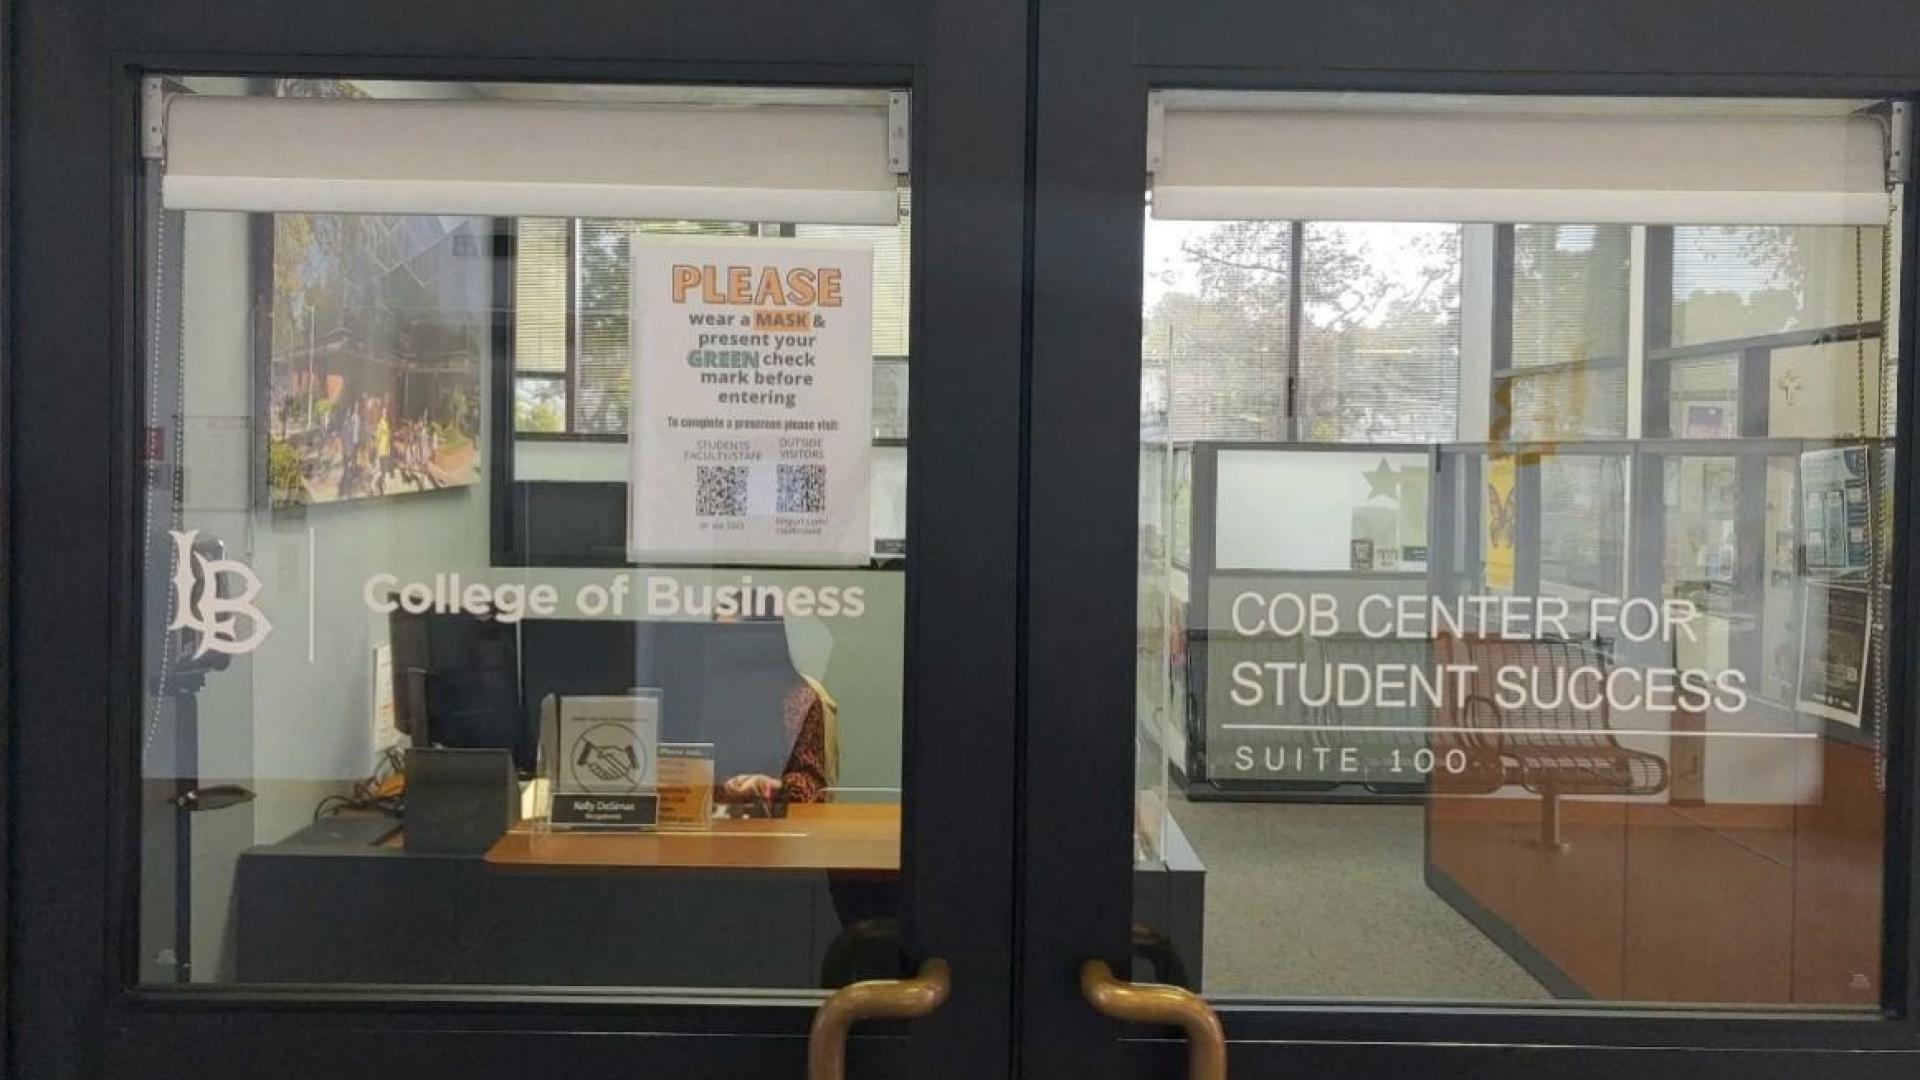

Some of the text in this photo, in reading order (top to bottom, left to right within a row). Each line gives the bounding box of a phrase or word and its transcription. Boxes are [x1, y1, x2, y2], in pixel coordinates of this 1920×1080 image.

[672, 264, 843, 307] PLEASE
[688, 312, 827, 328] wear a MASK &
[698, 332, 817, 350] present your
[687, 349, 816, 369] GREEN check
[700, 371, 814, 386] mark before
[717, 390, 797, 408] entering
[667, 416, 680, 428] To
[784, 419, 815, 431] please
[779, 438, 824, 448] OUTSIDE
[779, 450, 825, 459] VISITORS
[364, 572, 865, 623] College of Business
[1232, 592, 1699, 643] COB CENTER FOR
[1231, 661, 1747, 714] STUDENT SUCCESS
[1235, 745, 1467, 774] SUITE 100
